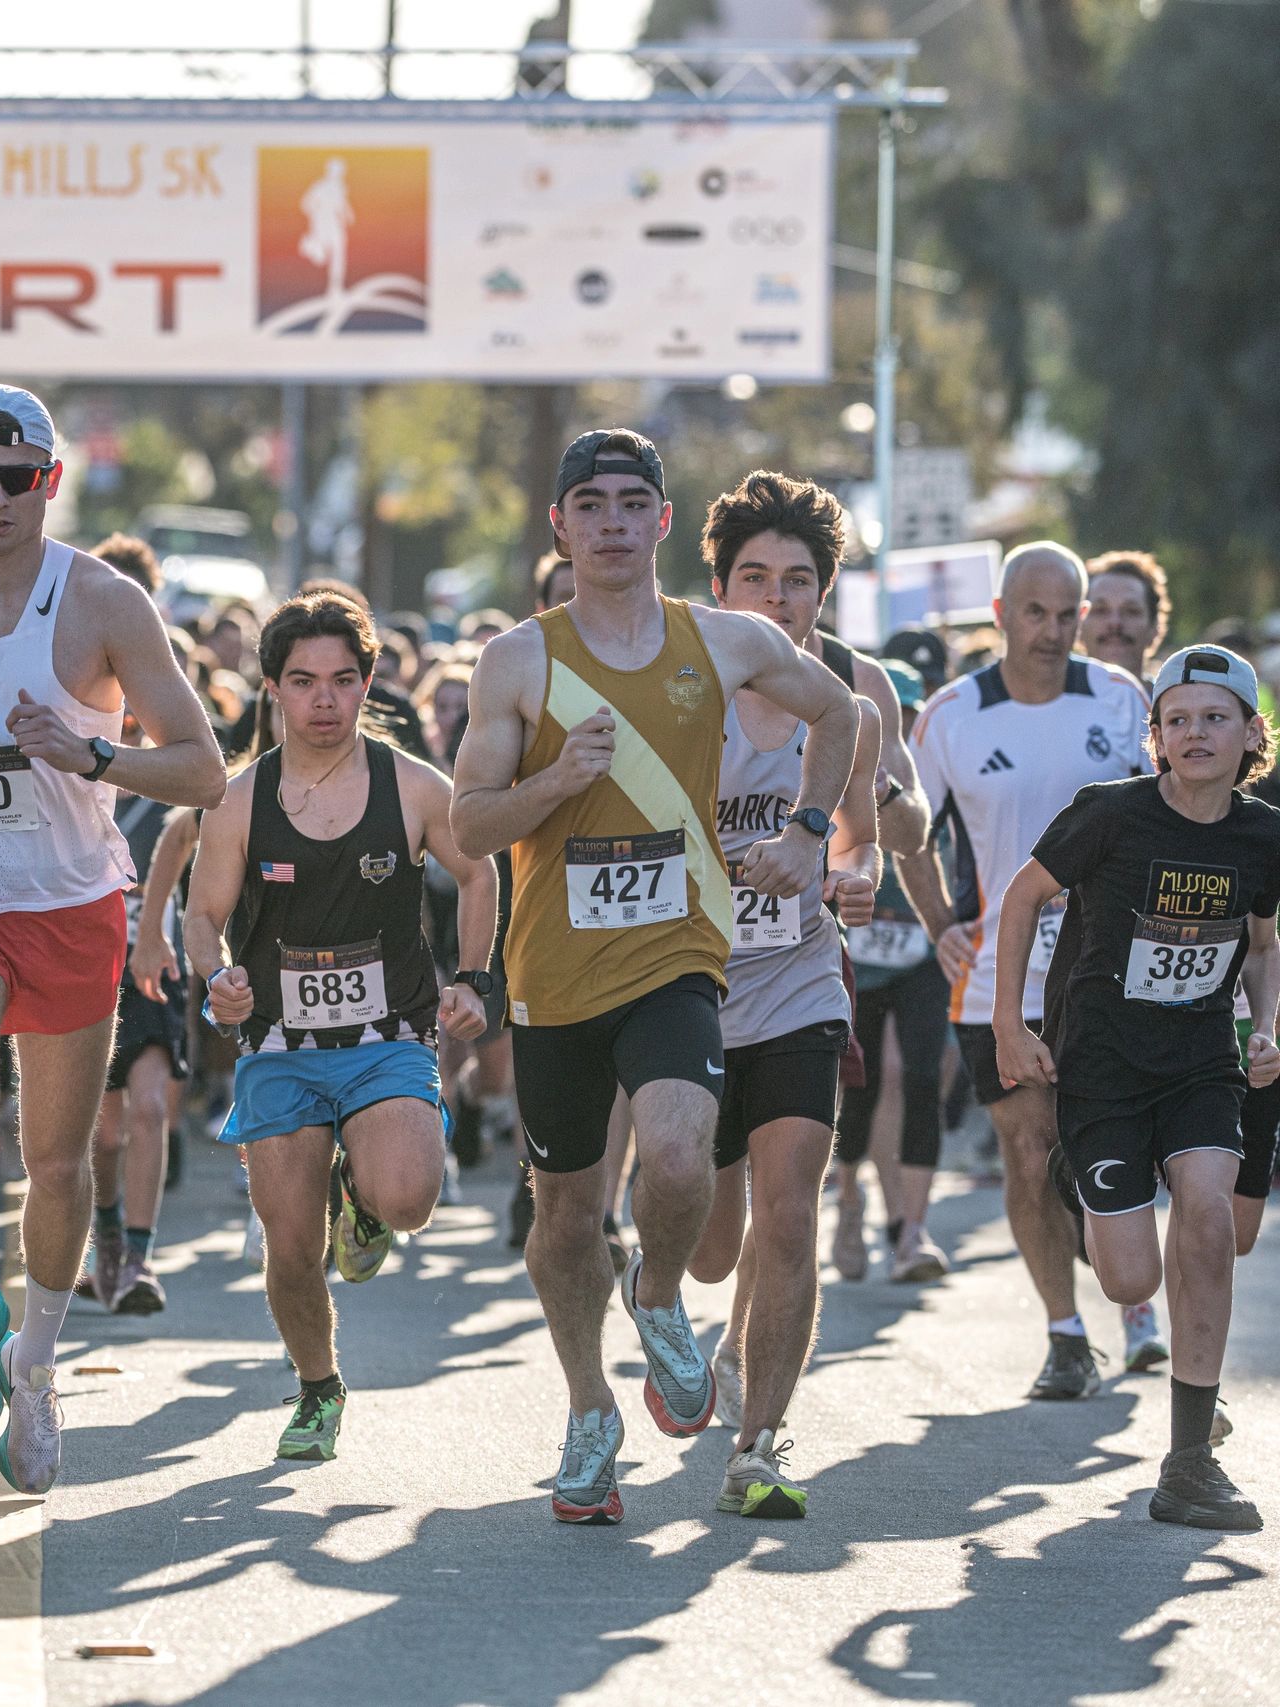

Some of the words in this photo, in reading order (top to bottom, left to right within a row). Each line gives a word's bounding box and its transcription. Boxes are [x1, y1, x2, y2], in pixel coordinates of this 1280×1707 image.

[2, 142, 148, 198] HILLS
[160, 145, 224, 197] 5K
[590, 862, 664, 904] 427
[1159, 870, 1230, 896] MISSION
[731, 889, 781, 925] 24
[1156, 893, 1208, 915] HILLS
[1211, 898, 1227, 906] SD
[1148, 946, 1219, 981] 383
[298, 970, 367, 1008] 683
